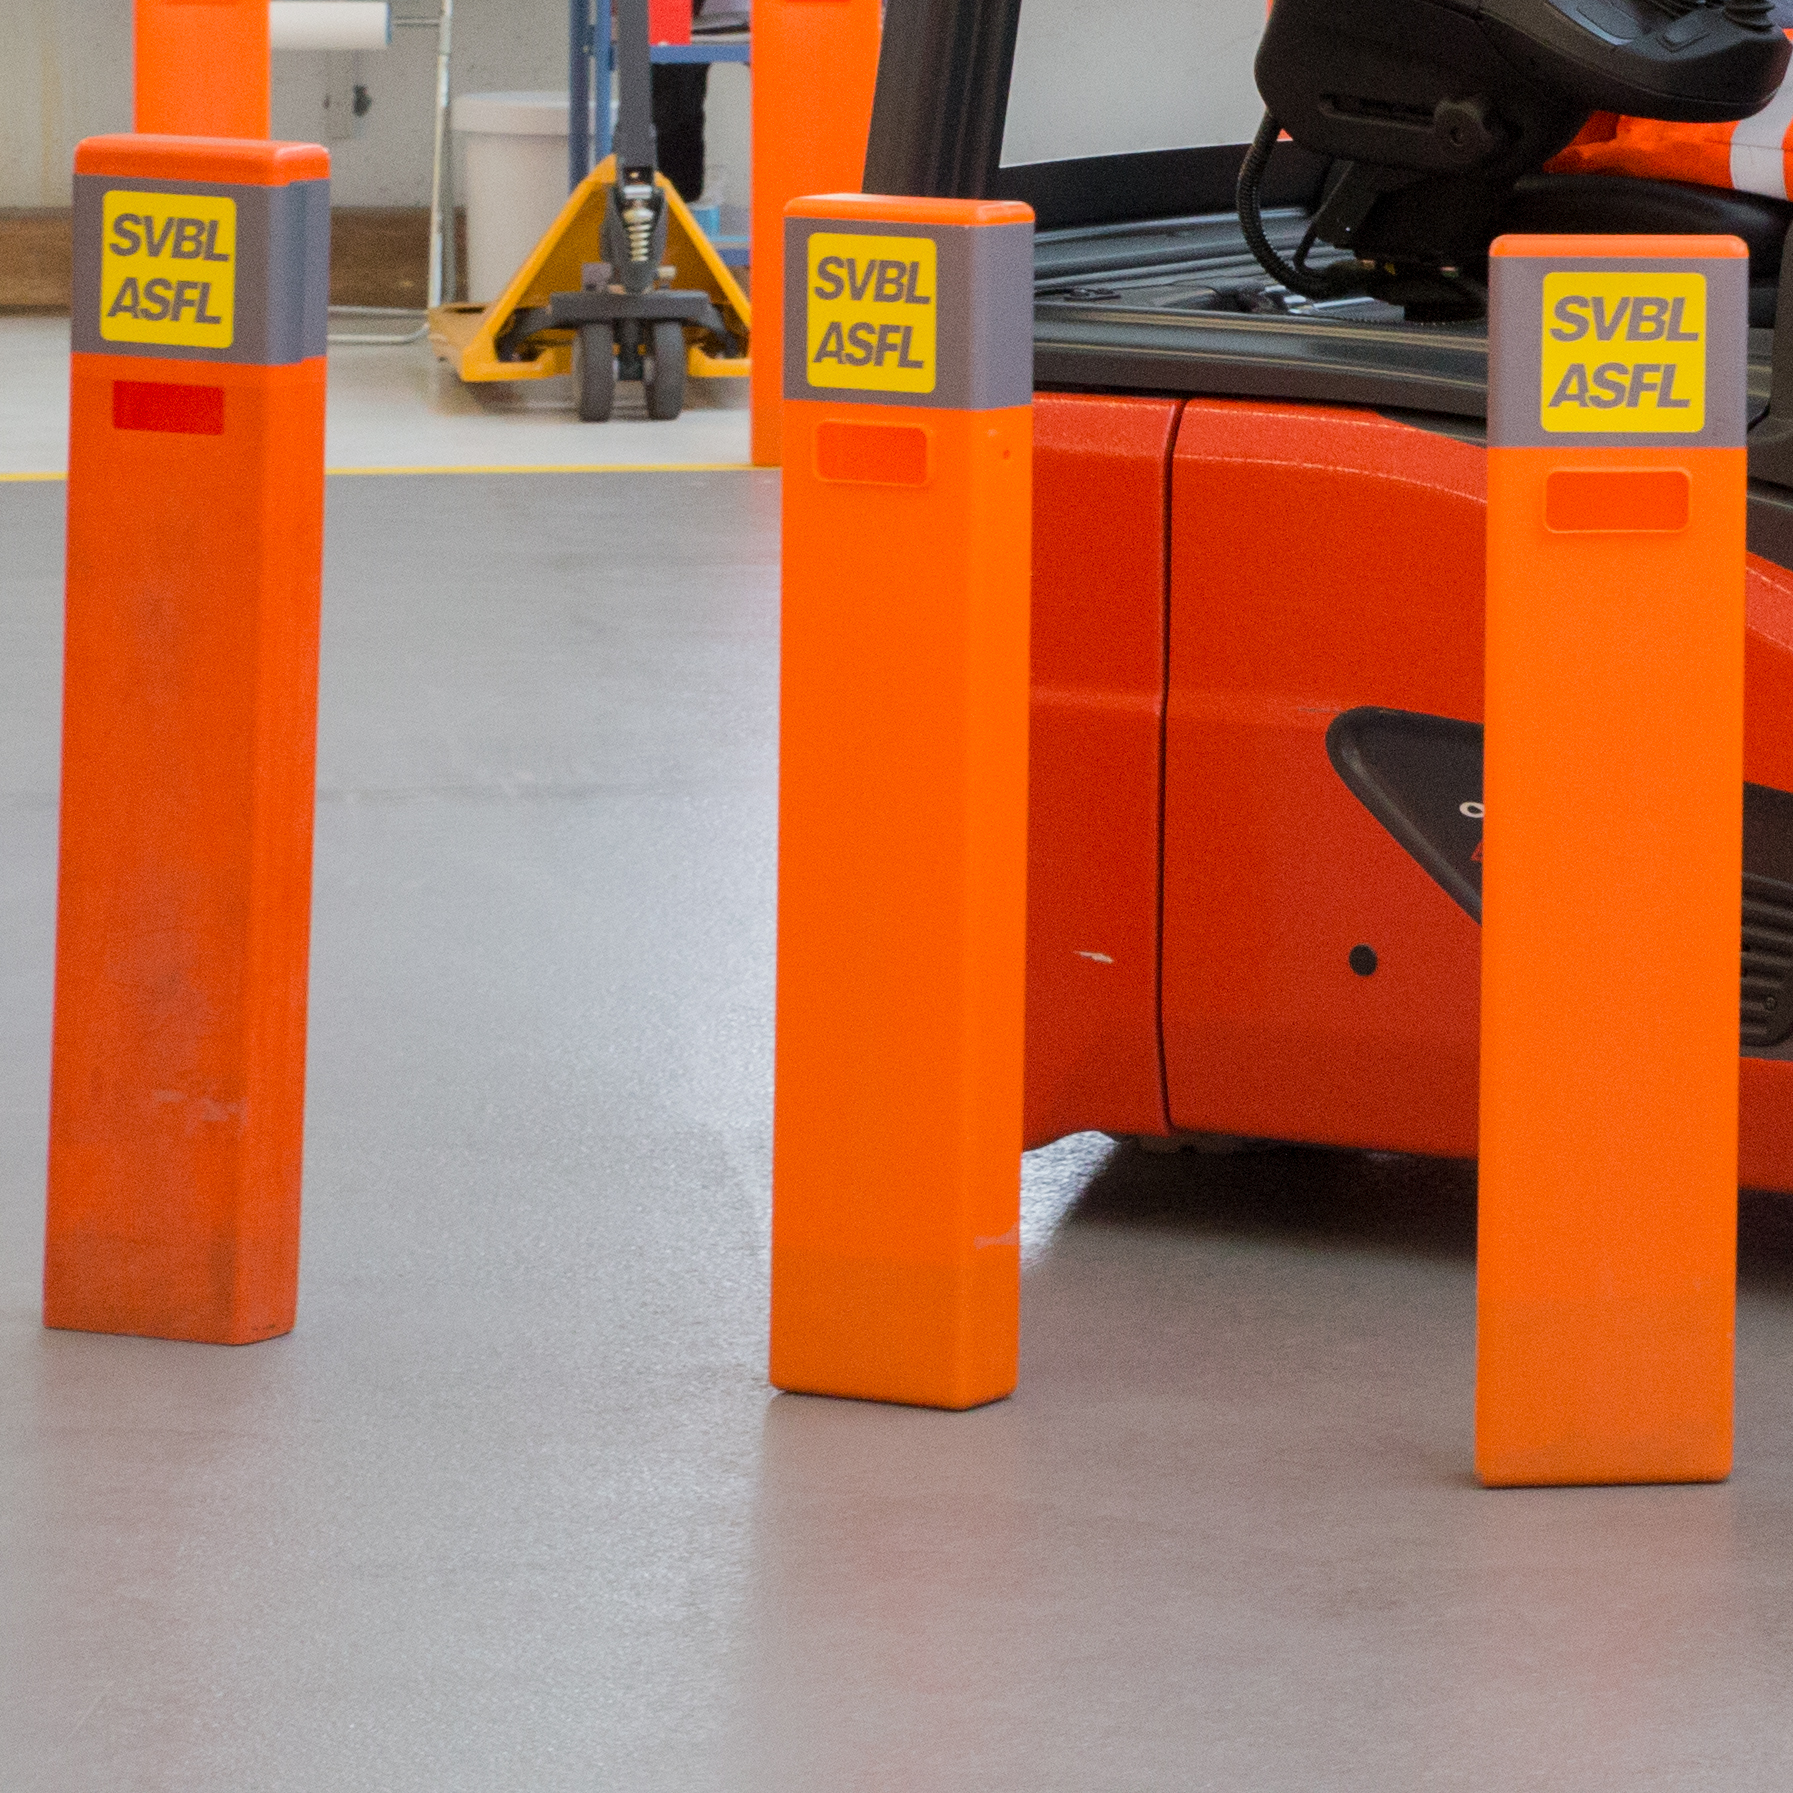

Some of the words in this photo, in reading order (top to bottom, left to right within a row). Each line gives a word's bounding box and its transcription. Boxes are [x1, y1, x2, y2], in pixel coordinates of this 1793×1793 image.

[109, 213, 231, 262] SVBL
[107, 277, 222, 325] ASFL
[814, 255, 932, 305] SVBL
[1550, 295, 1699, 342] SVBL
[813, 320, 924, 369] ASFL
[1549, 362, 1690, 409] ASFL
